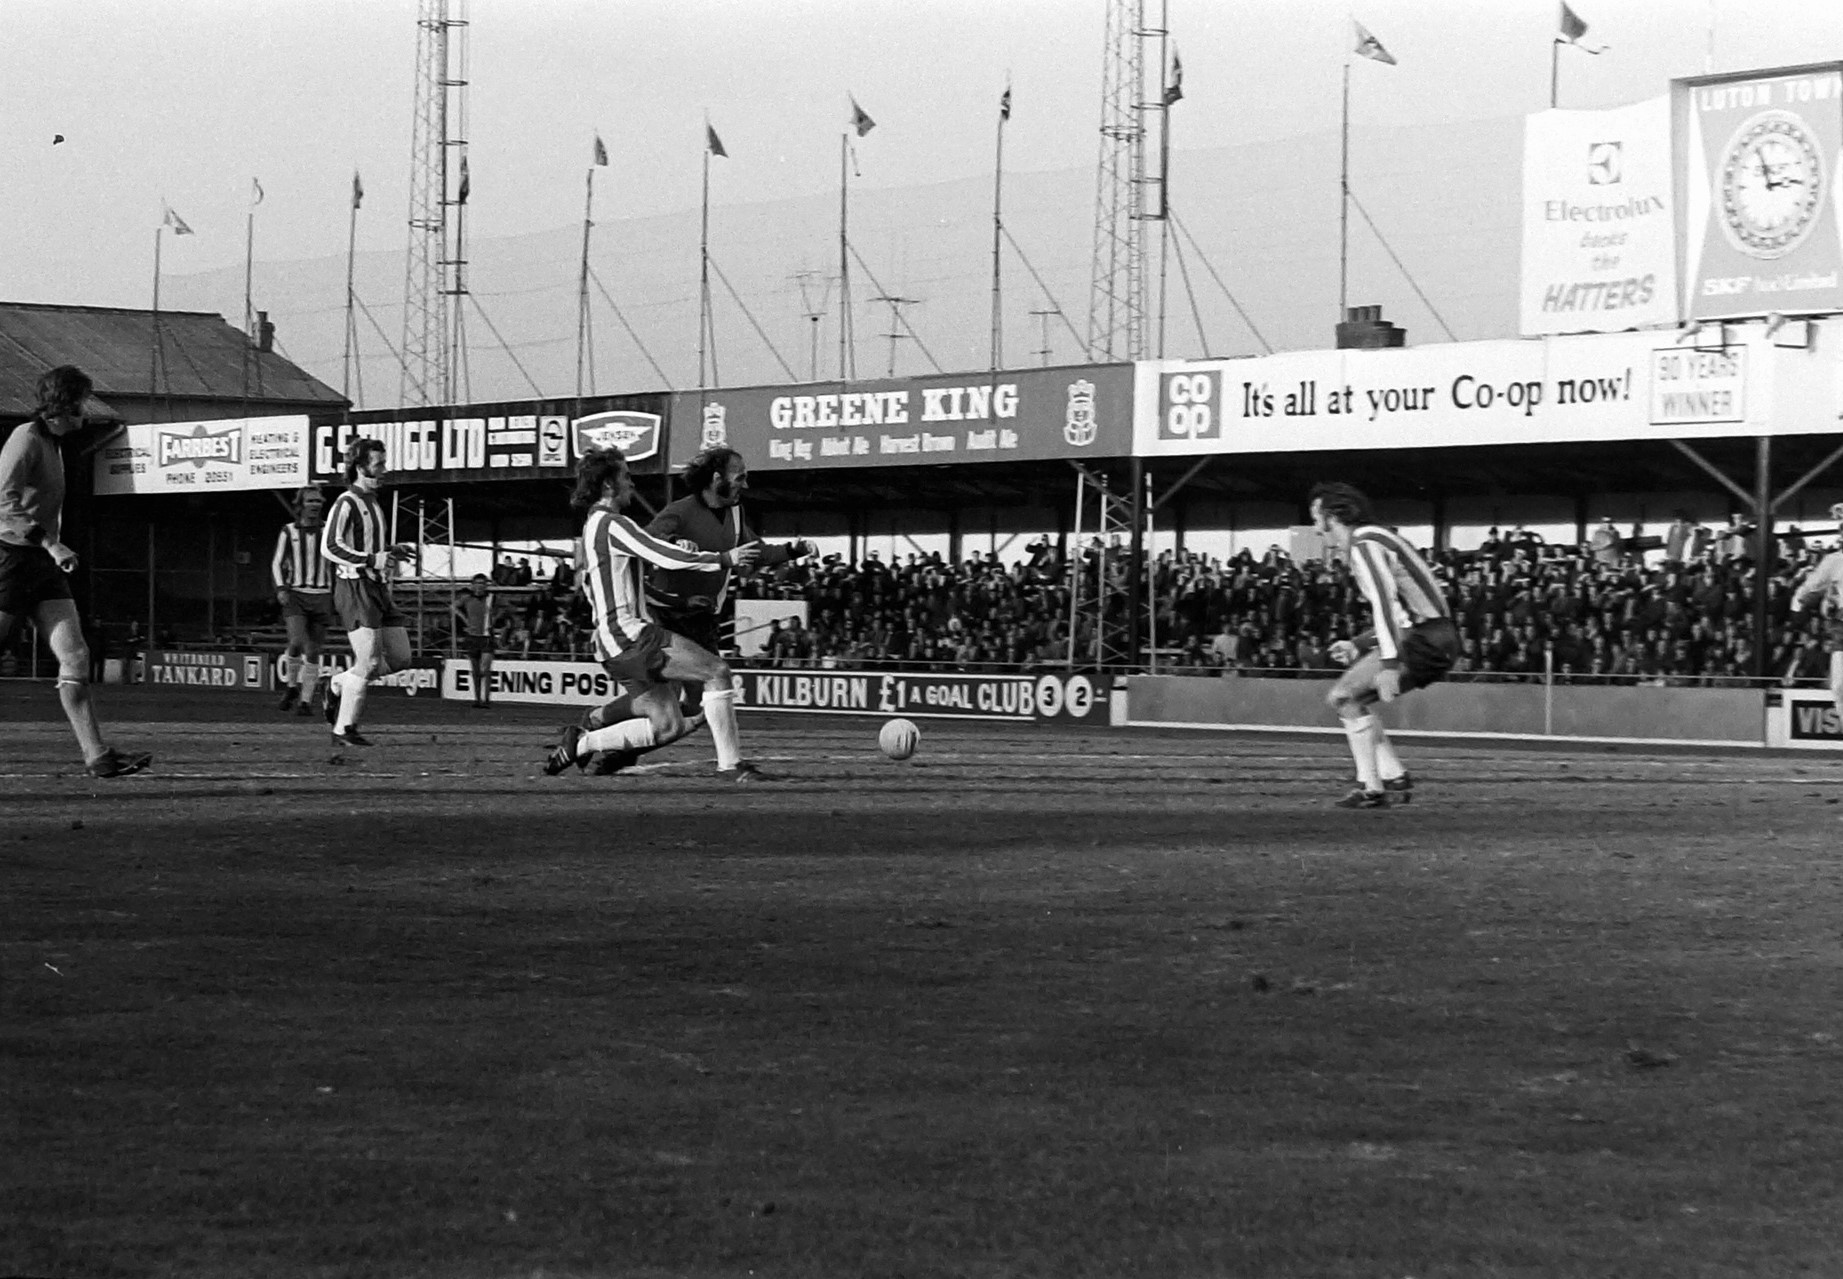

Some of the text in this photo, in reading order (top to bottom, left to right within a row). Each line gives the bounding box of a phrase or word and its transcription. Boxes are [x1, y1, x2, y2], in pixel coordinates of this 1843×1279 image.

[1701, 84, 1771, 111] LUTON
[1545, 196, 1665, 222] Electrolux
[1542, 273, 1655, 312] HATTERS
[1686, 351, 1739, 380] YEARS
[770, 384, 1020, 429] GREENE KING
[1243, 367, 1632, 422] It's all at your Co-op now!
[1662, 390, 1733, 418] WINNER
[162, 430, 242, 466] FARRBEST
[442, 418, 486, 470] LTD
[166, 472, 196, 484] PHONE
[151, 665, 237, 687] TANKARD
[455, 669, 553, 694] EENING
[756, 675, 868, 709] KILBURN
[878, 674, 907, 712] £1
[909, 685, 923, 704] A
[925, 684, 974, 710] GOAL
[976, 681, 1036, 716] CLUB
